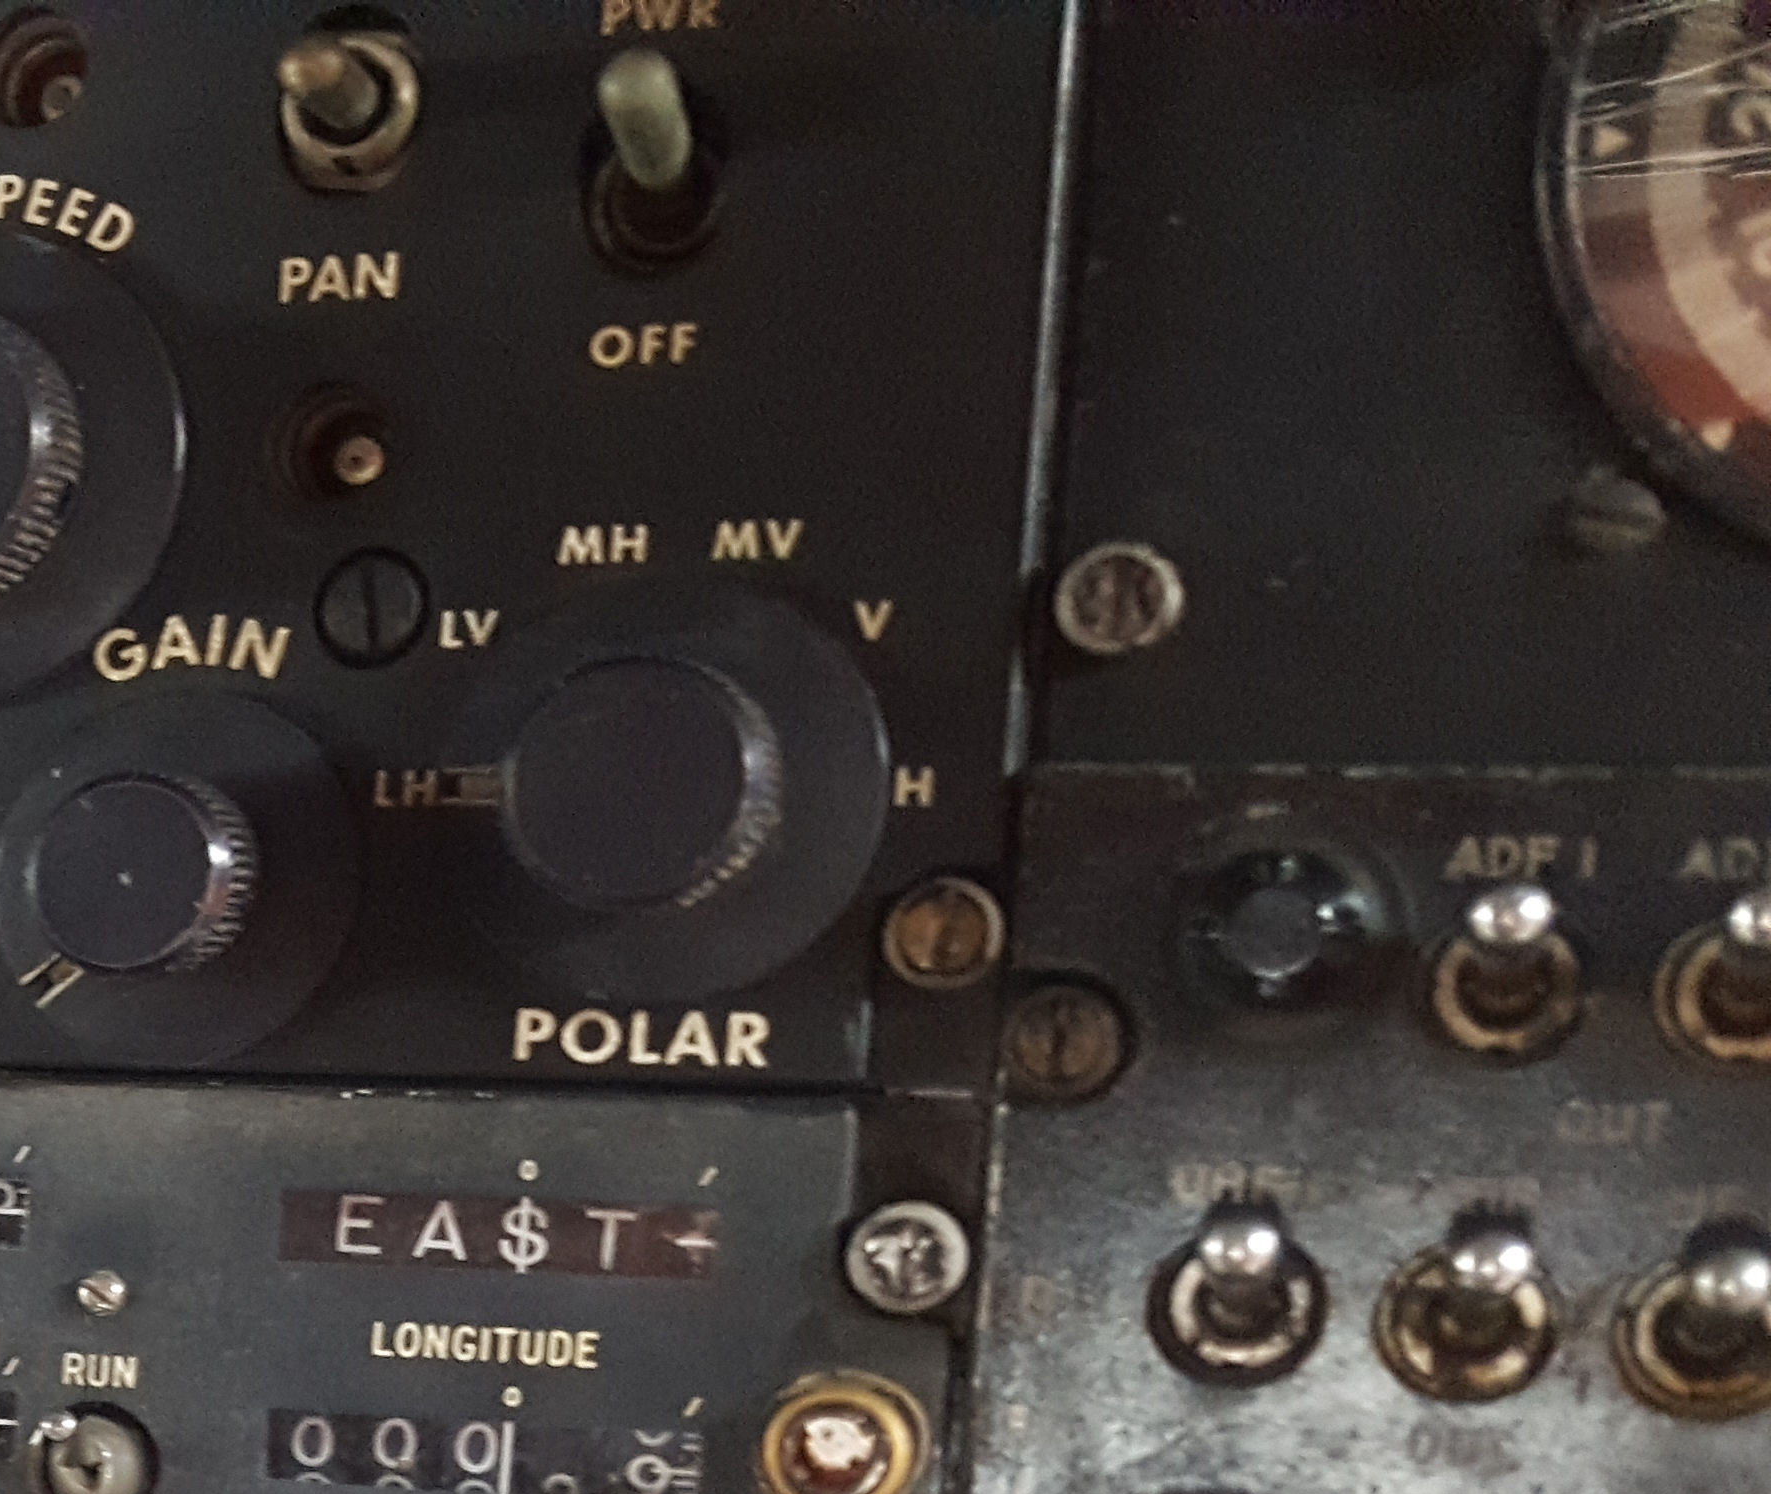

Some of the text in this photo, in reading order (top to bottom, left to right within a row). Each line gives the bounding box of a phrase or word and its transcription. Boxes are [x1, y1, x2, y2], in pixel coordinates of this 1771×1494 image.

[598, 0, 722, 34] PWR
[277, 252, 402, 304] PAN
[589, 322, 699, 368] OFF
[557, 523, 648, 566] MH
[711, 518, 804, 562] MV
[438, 609, 499, 650] LV
[854, 600, 893, 641] V
[94, 613, 290, 684] GAIN
[373, 769, 437, 809] LH
[893, 766, 935, 807] H
[1443, 835, 1557, 879] ADF
[512, 1007, 771, 1068] POLAR
[370, 1320, 602, 1371] LONGITUDE
[62, 1352, 139, 1389] RUN
